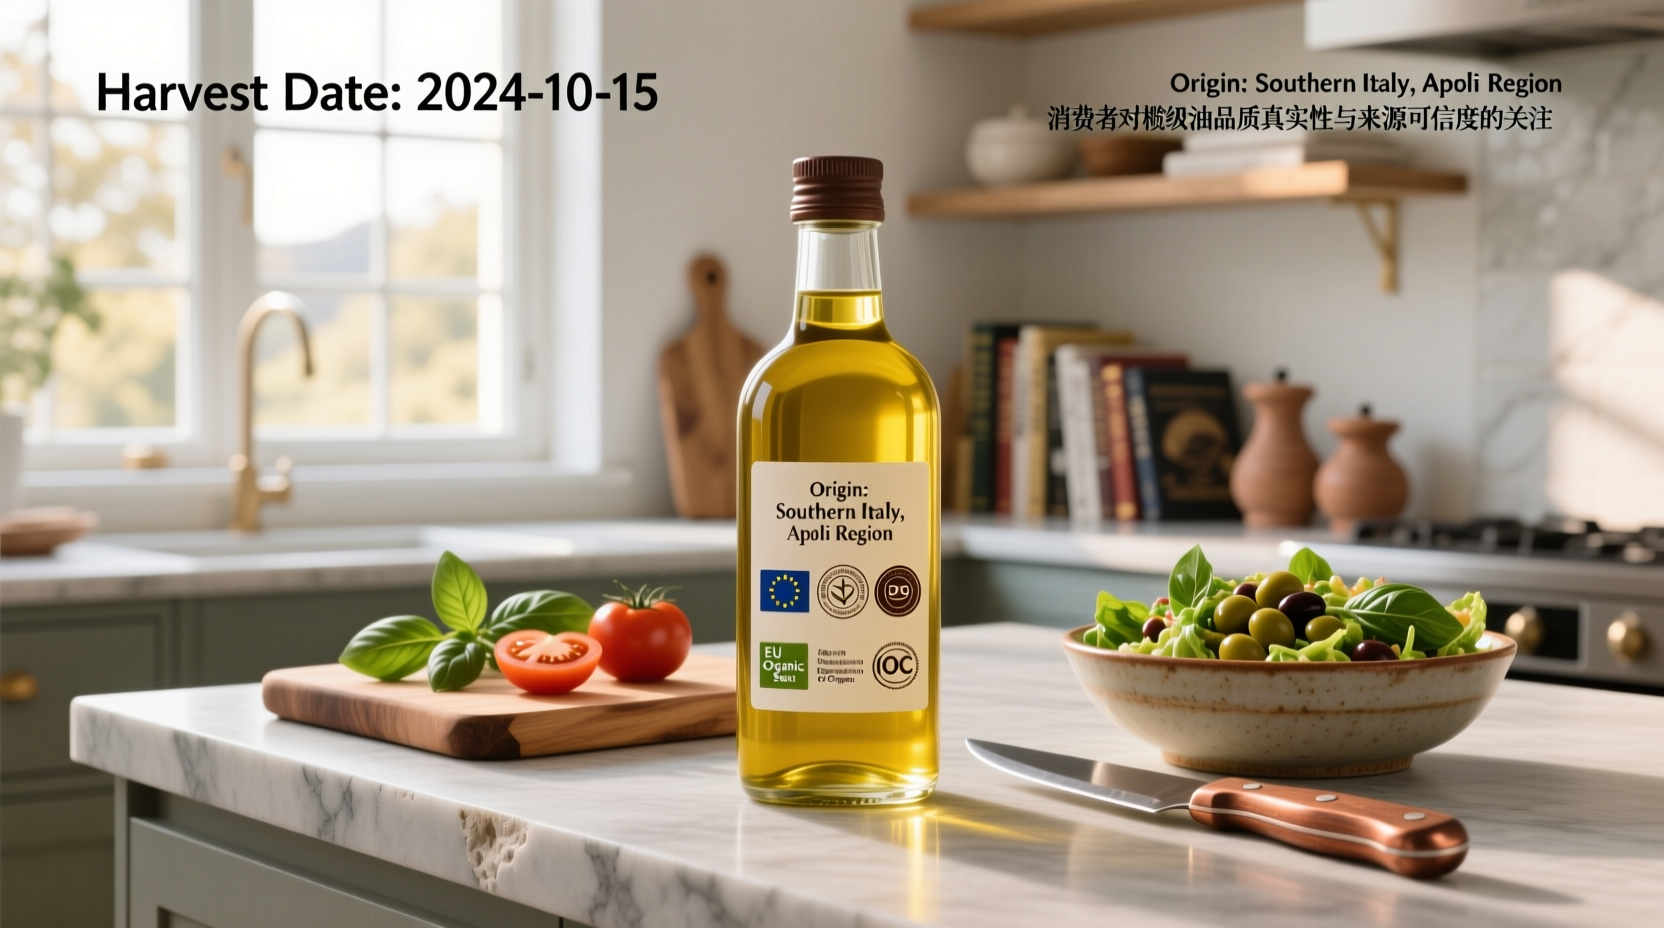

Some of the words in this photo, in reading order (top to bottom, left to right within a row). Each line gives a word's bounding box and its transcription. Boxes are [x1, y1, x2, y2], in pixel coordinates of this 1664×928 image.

[809, 480, 869, 502] Origin:
[776, 502, 856, 520] Southern
[861, 501, 905, 524] Italy,
[786, 524, 830, 546] Apoli
[836, 524, 893, 546] Region
[764, 646, 782, 659] EU
